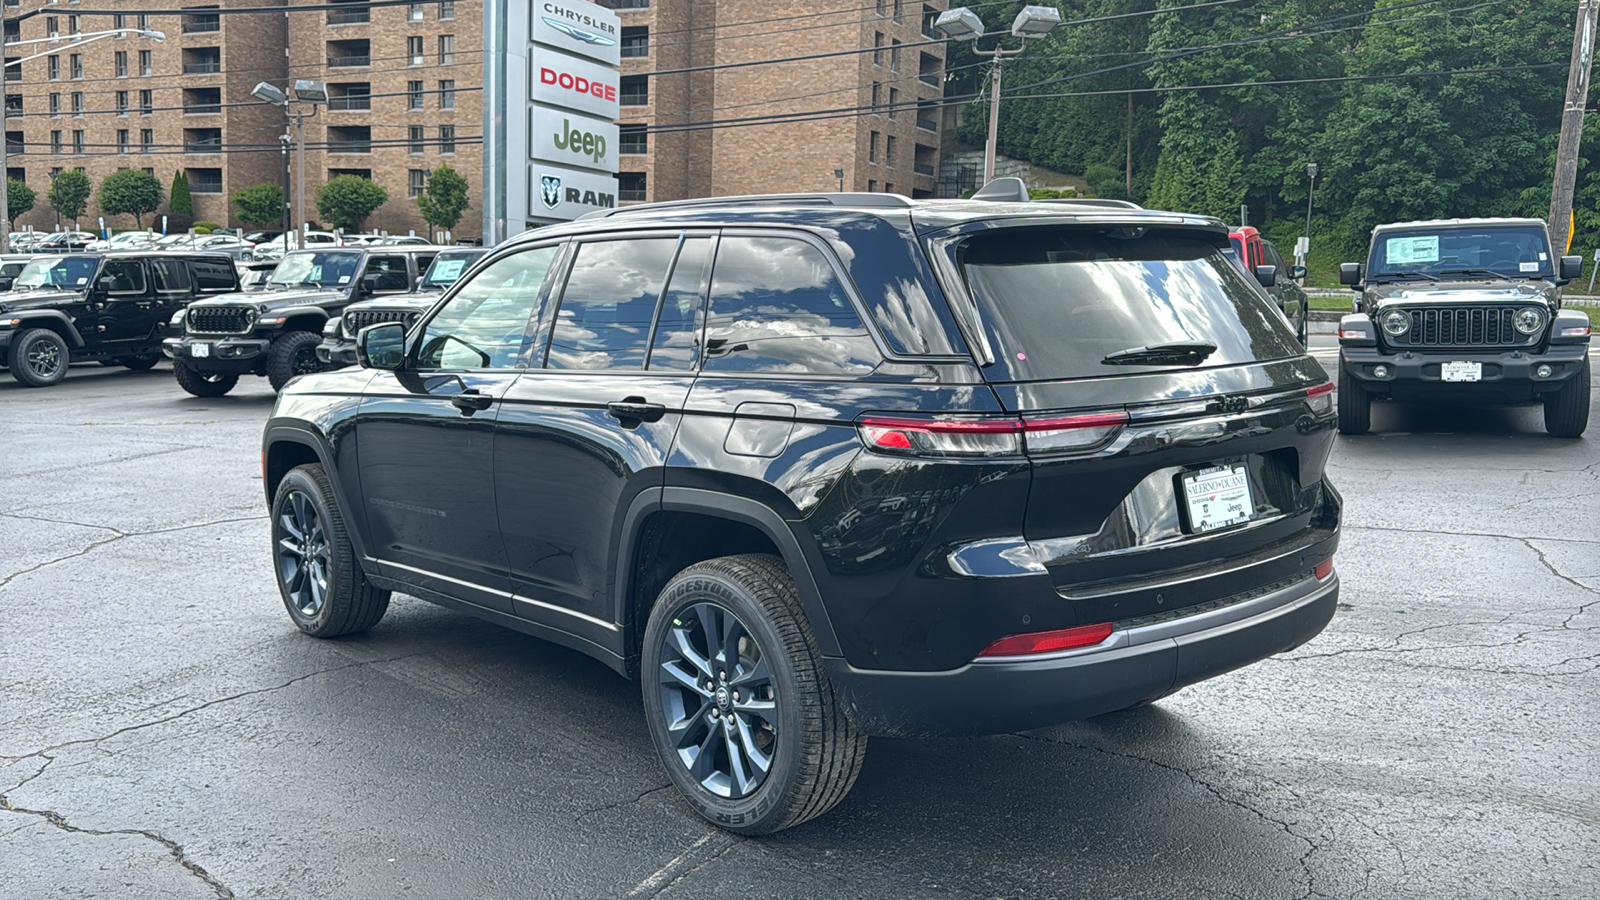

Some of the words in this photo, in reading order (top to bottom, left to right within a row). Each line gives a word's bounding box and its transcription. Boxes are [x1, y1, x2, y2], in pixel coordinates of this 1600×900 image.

[543, 3, 615, 34] CHRYSLER
[541, 67, 616, 102] DODGE
[553, 118, 606, 163] Jeep
[565, 187, 615, 208] RAM
[1187, 481, 1218, 496] SALERNO
[1221, 476, 1246, 489] DUANE
[1227, 503, 1243, 513] Jeep
